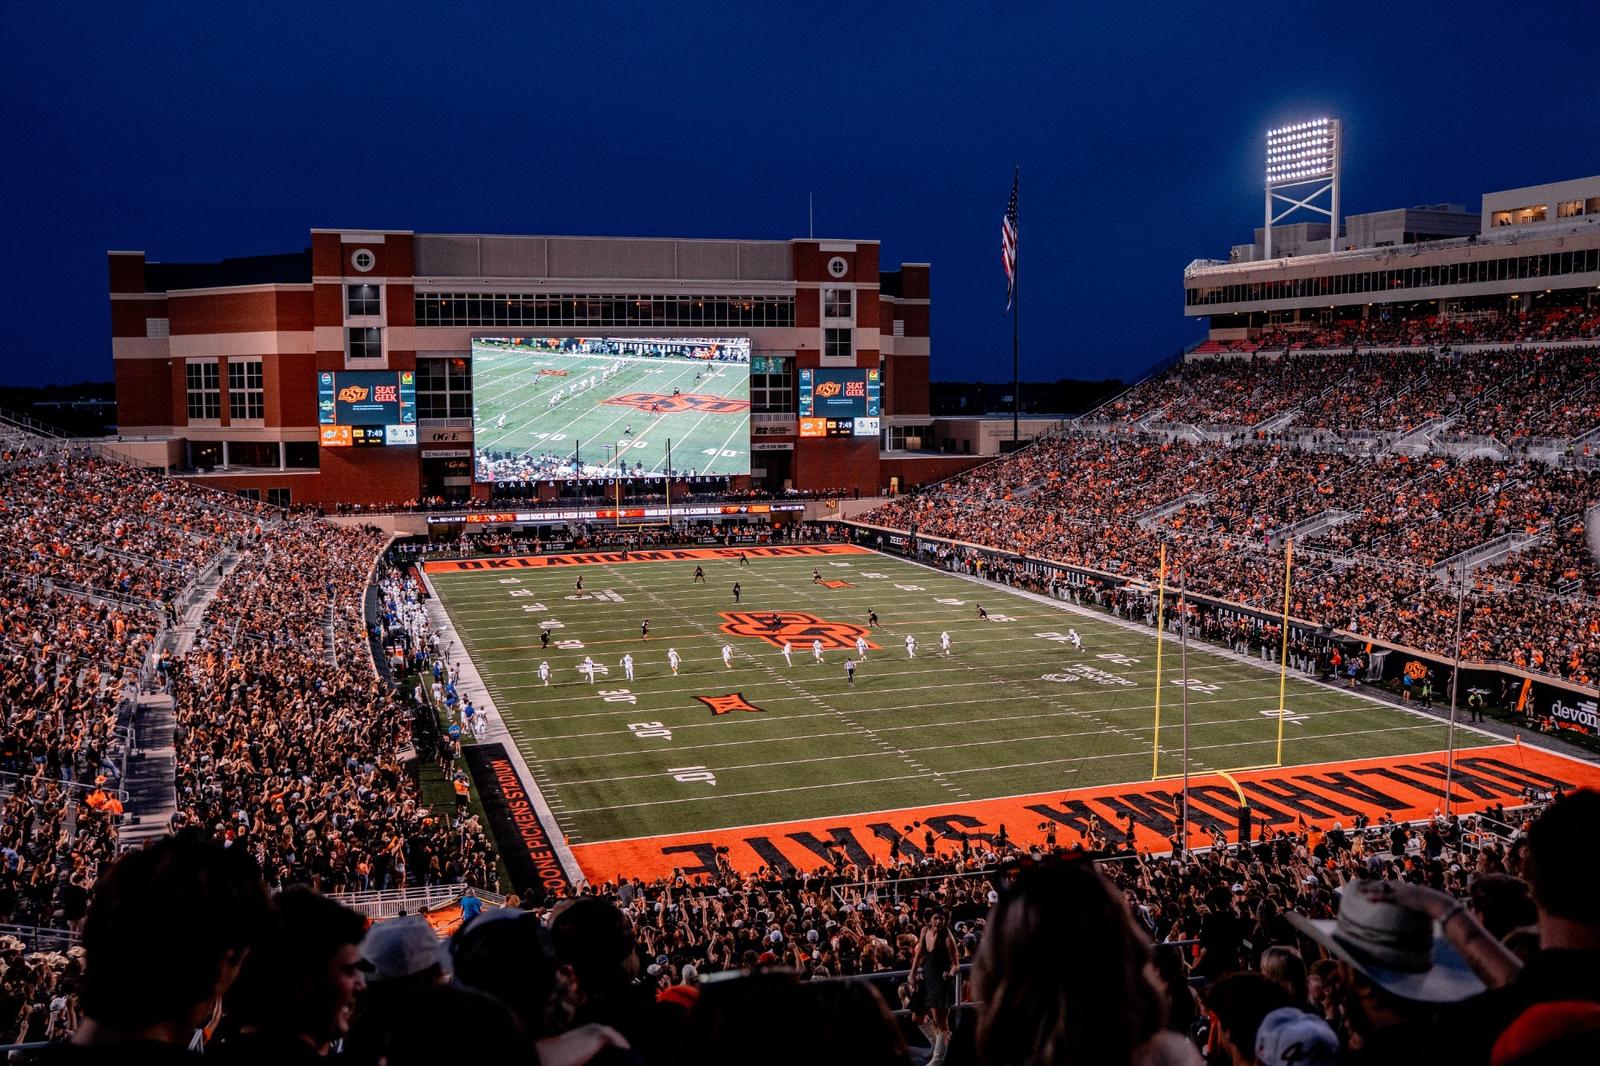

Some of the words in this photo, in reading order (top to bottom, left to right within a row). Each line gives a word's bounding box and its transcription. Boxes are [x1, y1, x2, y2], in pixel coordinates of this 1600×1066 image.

[338, 386, 369, 403] OSU
[375, 385, 396, 394] SEAT
[375, 393, 397, 402] GEEK
[815, 382, 841, 397] OSU
[846, 389, 865, 397] GEEK
[404, 429, 414, 437] 13
[870, 421, 878, 429] 13
[498, 481, 537, 489] GARY
[567, 478, 633, 487] CLAUDIA
[826, 500, 836, 508] 40
[457, 551, 699, 570] OKLAHOMA
[714, 547, 842, 558] STATE
[1404, 661, 1428, 680] OSU
[1551, 699, 1599, 728] devon
[627, 721, 672, 738] 20
[491, 758, 525, 799] STADIUM
[1023, 755, 1577, 848] OKLAHOMA
[509, 800, 547, 849] PICKENS
